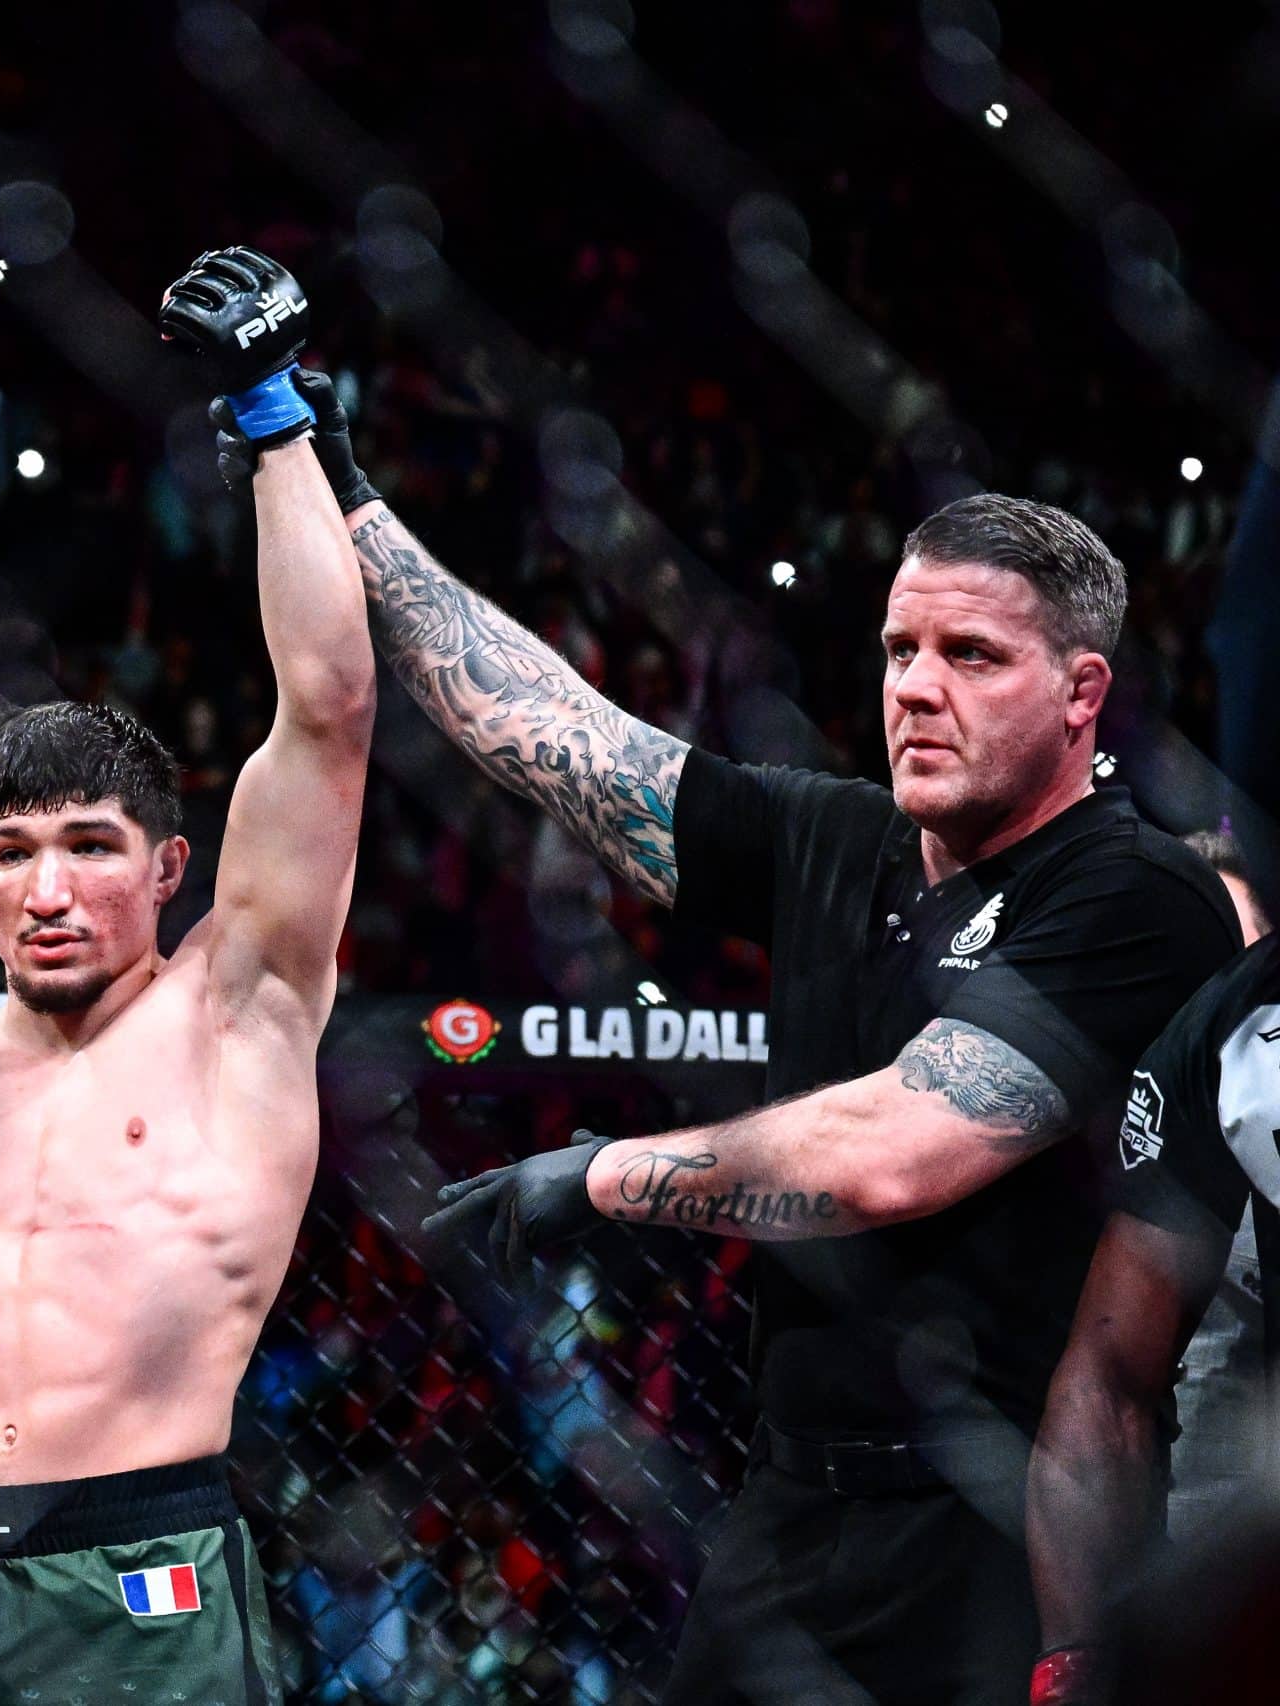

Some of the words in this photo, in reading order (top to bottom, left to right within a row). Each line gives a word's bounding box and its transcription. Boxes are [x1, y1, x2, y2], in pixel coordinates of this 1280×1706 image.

[234, 295, 309, 350] PFL
[441, 1007, 479, 1046] G
[569, 1007, 635, 1060] LA
[618, 1151, 838, 1225] Fortune
